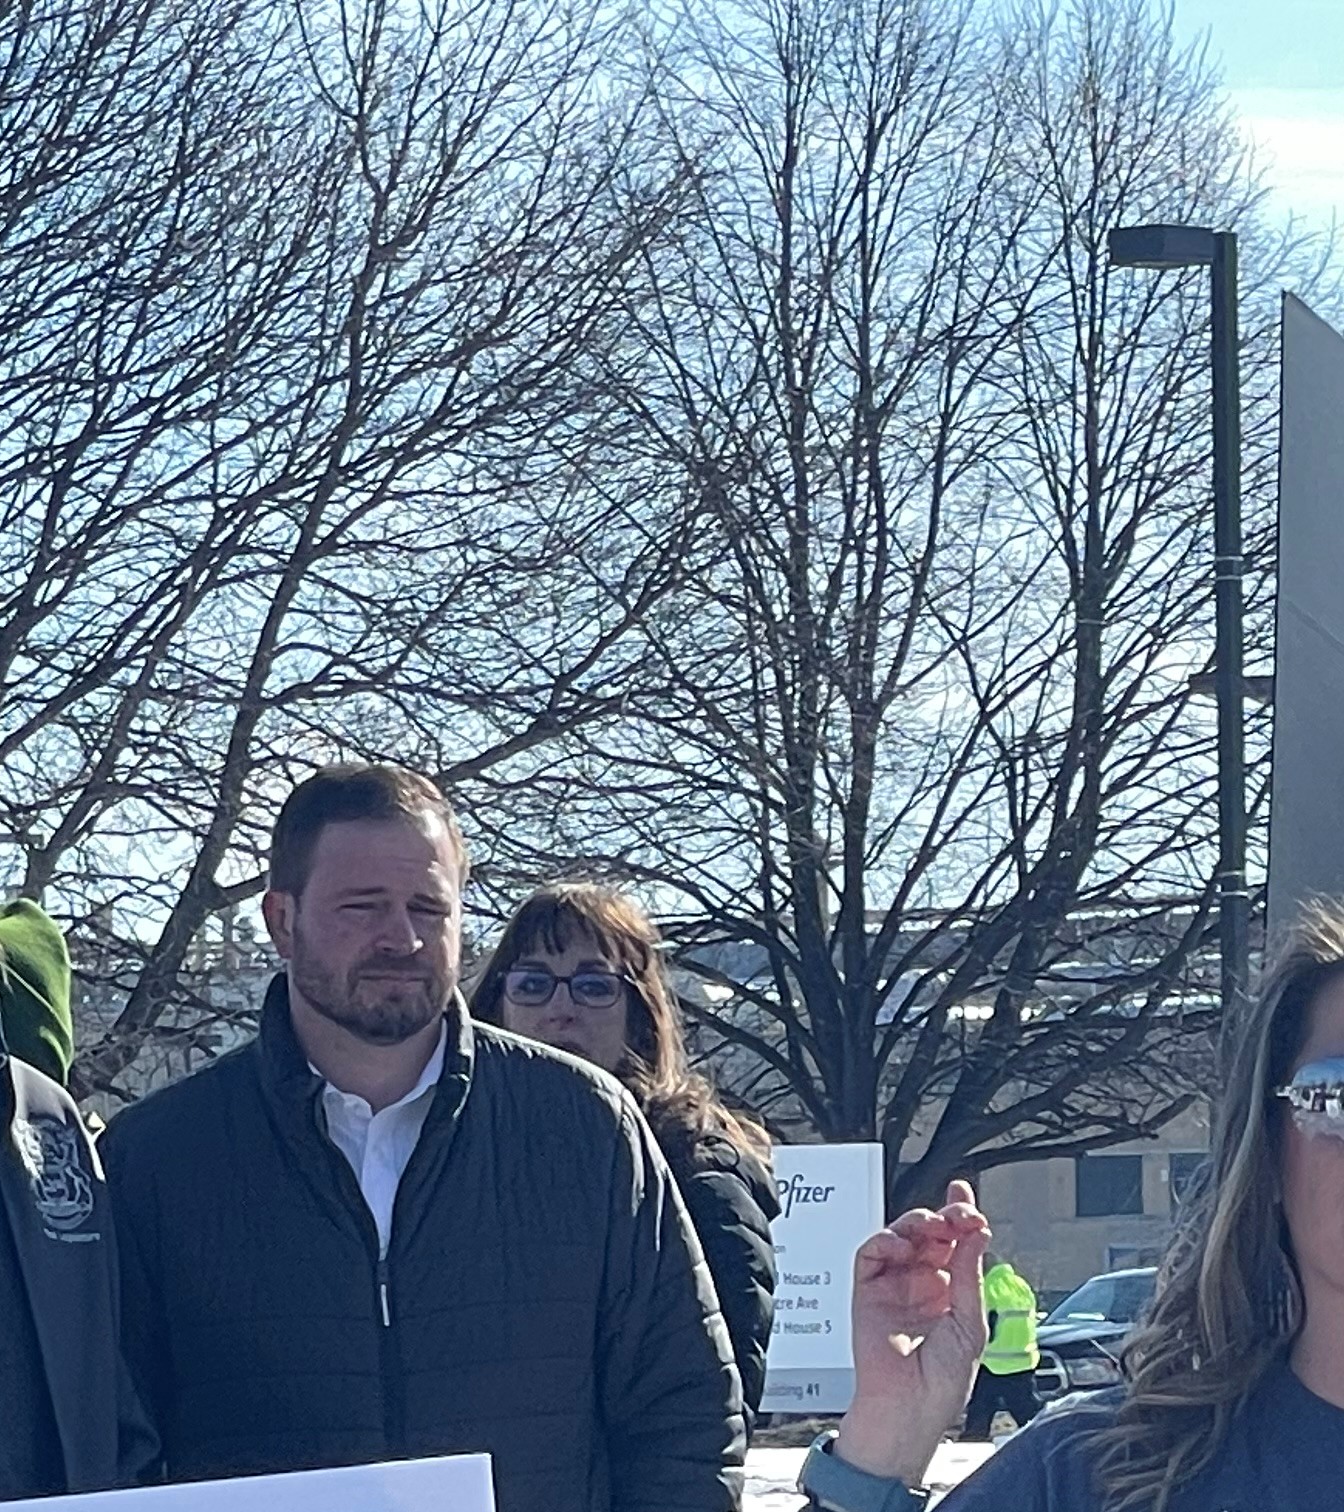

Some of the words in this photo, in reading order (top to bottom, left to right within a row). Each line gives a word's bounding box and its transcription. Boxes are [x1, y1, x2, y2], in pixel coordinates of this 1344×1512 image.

[777, 1173, 835, 1218] Pfizer
[783, 1272, 820, 1285] House
[796, 1296, 818, 1310] Ave
[825, 1320, 832, 1334] 5
